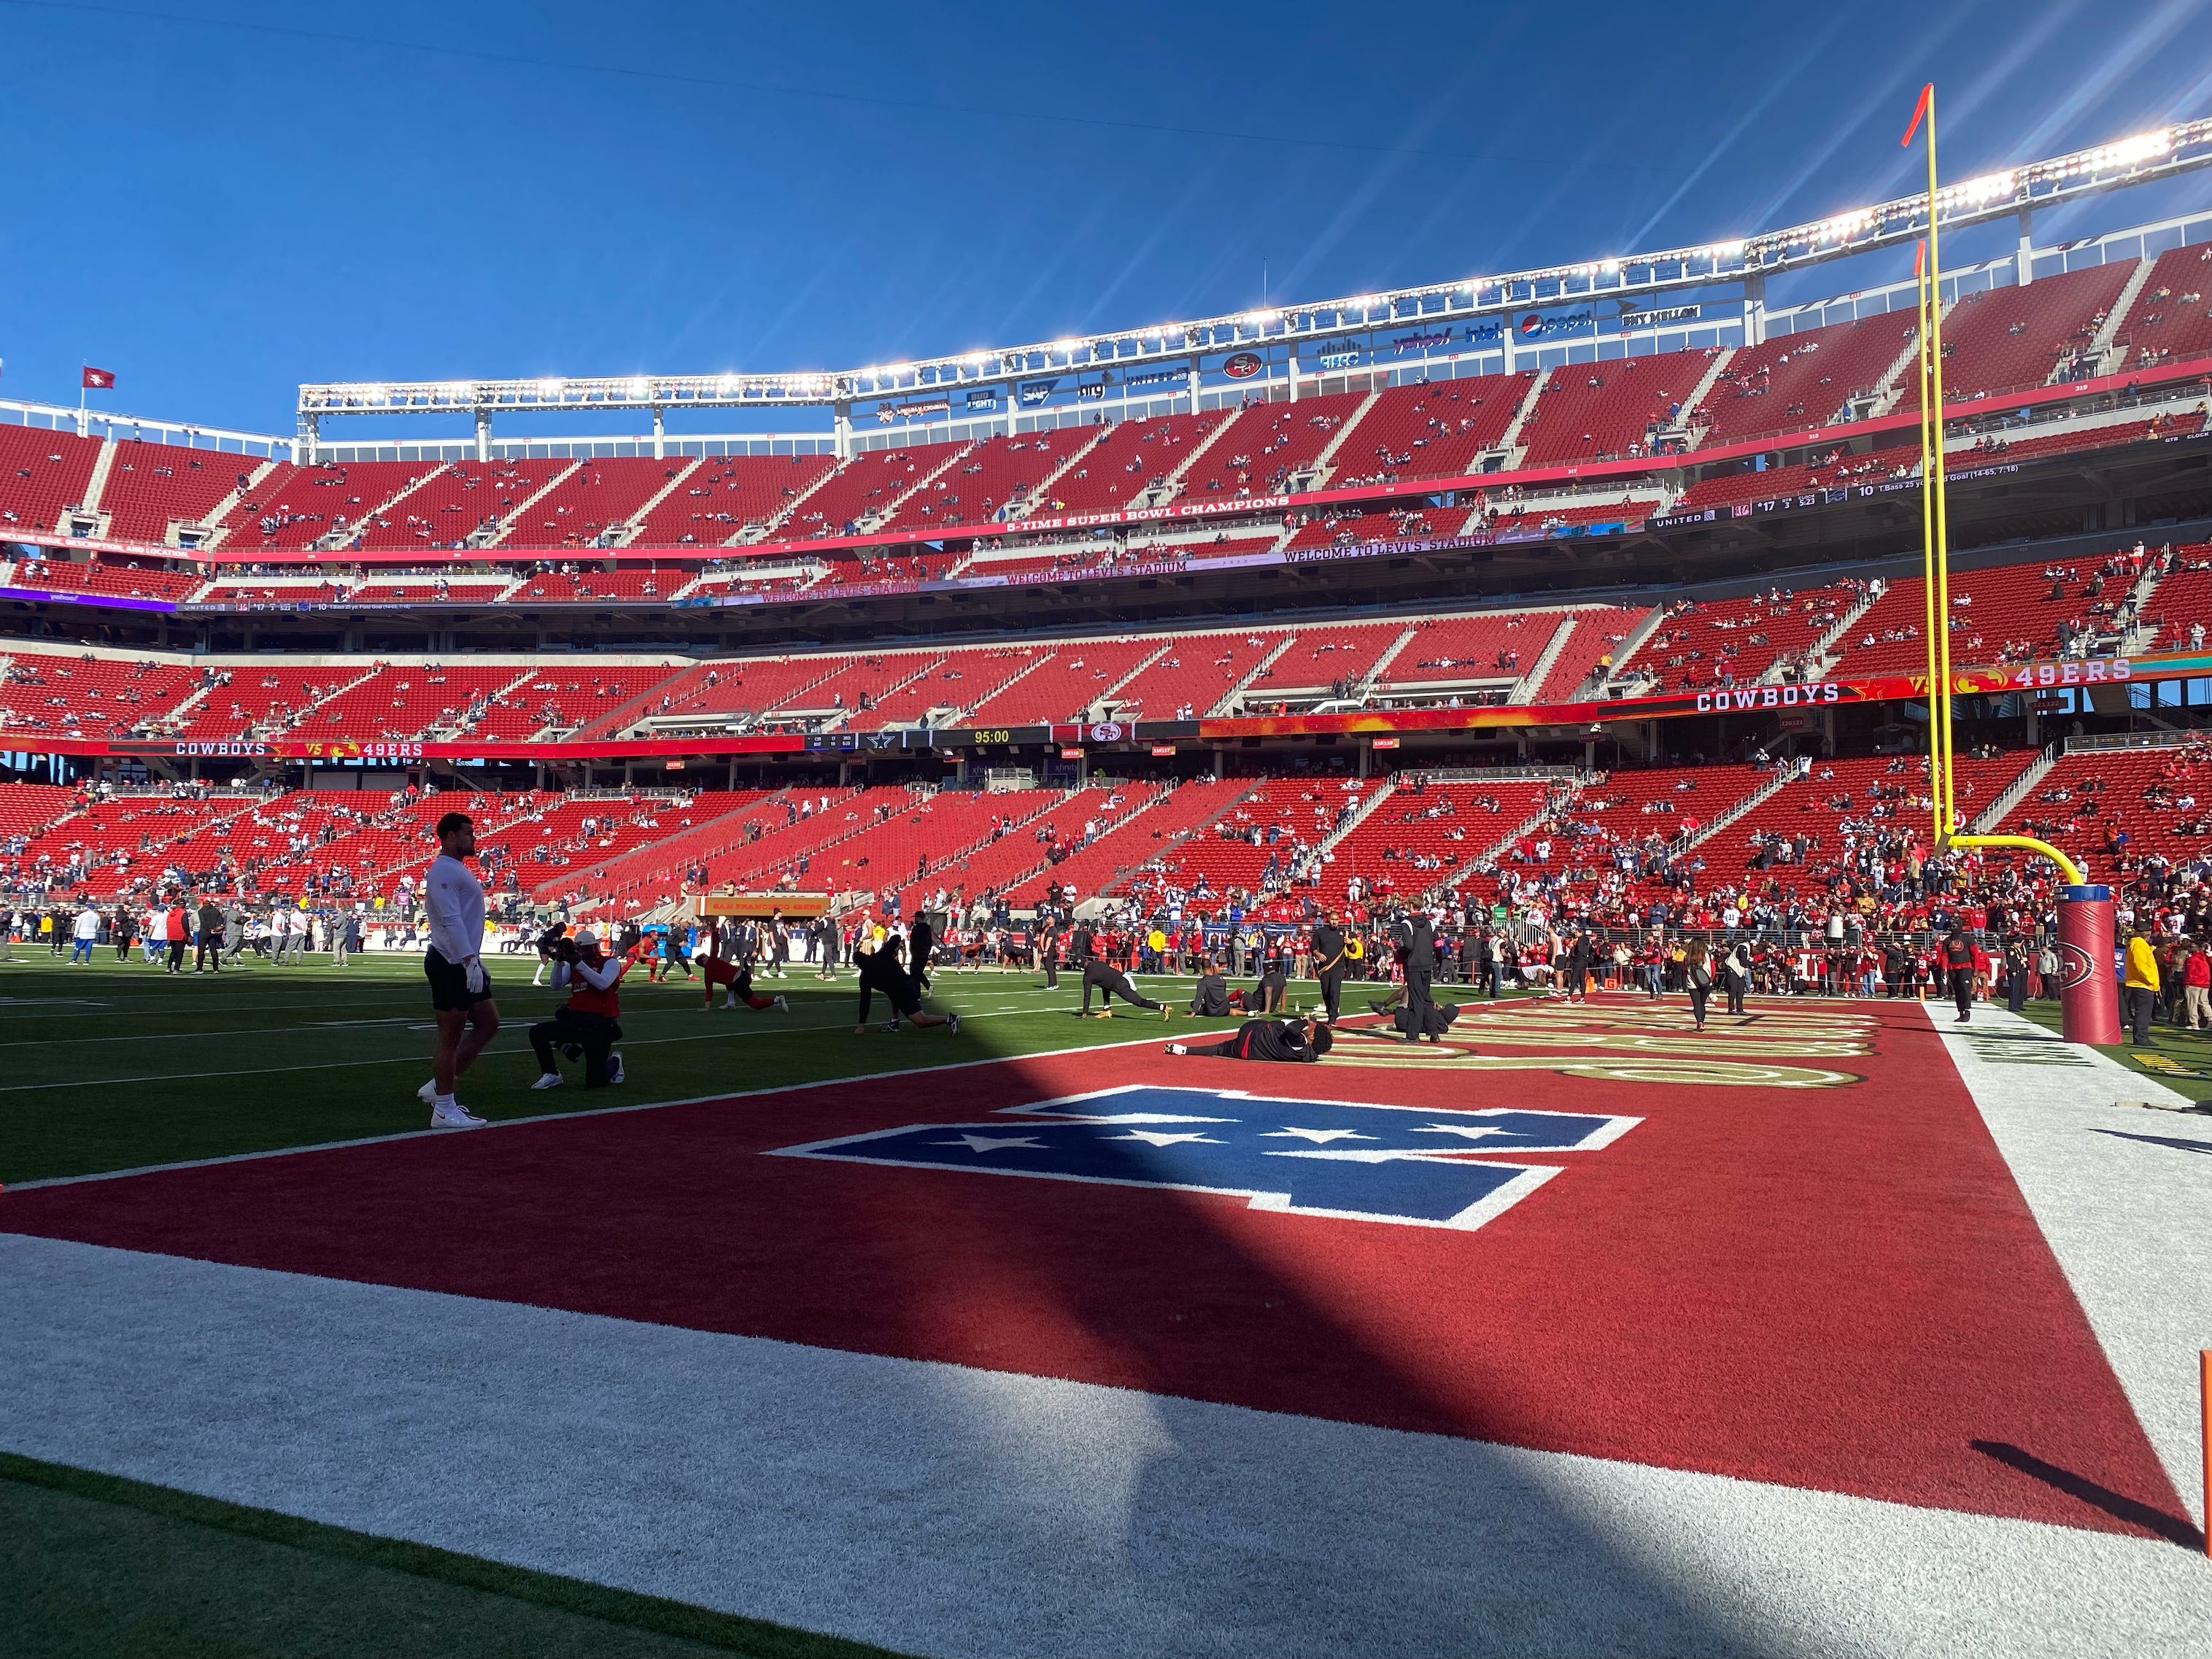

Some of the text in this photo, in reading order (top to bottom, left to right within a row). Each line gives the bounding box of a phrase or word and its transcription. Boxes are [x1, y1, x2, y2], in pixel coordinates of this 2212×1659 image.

[1544, 311, 1592, 333] pepsi
[1623, 306, 1698, 326] BNY MELLON
[1466, 322, 1499, 343] intel
[971, 392, 989, 400] BUD
[1023, 384, 1049, 400] SAP
[1080, 384, 1105, 399] nrg
[968, 398, 993, 409] LIGHT
[2187, 432, 2209, 440] CLOCK
[1860, 486, 1873, 496] 10
[1879, 483, 1903, 492] T.Bass
[1905, 480, 1914, 489] 25
[1949, 473, 1968, 482] Goal
[1999, 464, 2019, 474] 7:18)
[1799, 498, 1815, 506] 5:23
[1007, 495, 1290, 532] 5-TIME SUPER BOWL CHAMPIONS
[1657, 514, 1701, 527] UNITED
[125, 545, 145, 554] AND
[146, 546, 190, 558] LOCATION.
[1284, 534, 1496, 562] WELCOME TO LEVI'S STADIUM
[1008, 561, 1187, 584] WELCOME TO LEVI'S STADIUM
[762, 582, 919, 603] WELCOME TO LEVI'S STADIUM
[2015, 658, 2130, 687] 49ERS
[1697, 683, 1839, 712] COWBOYS
[975, 730, 1009, 743] 95:00
[175, 743, 423, 757] COWBOYS VS 49ERS
[1055, 763, 1078, 772] xfinity
[1936, 914, 1942, 923] 7
[1608, 980, 1614, 988] G
